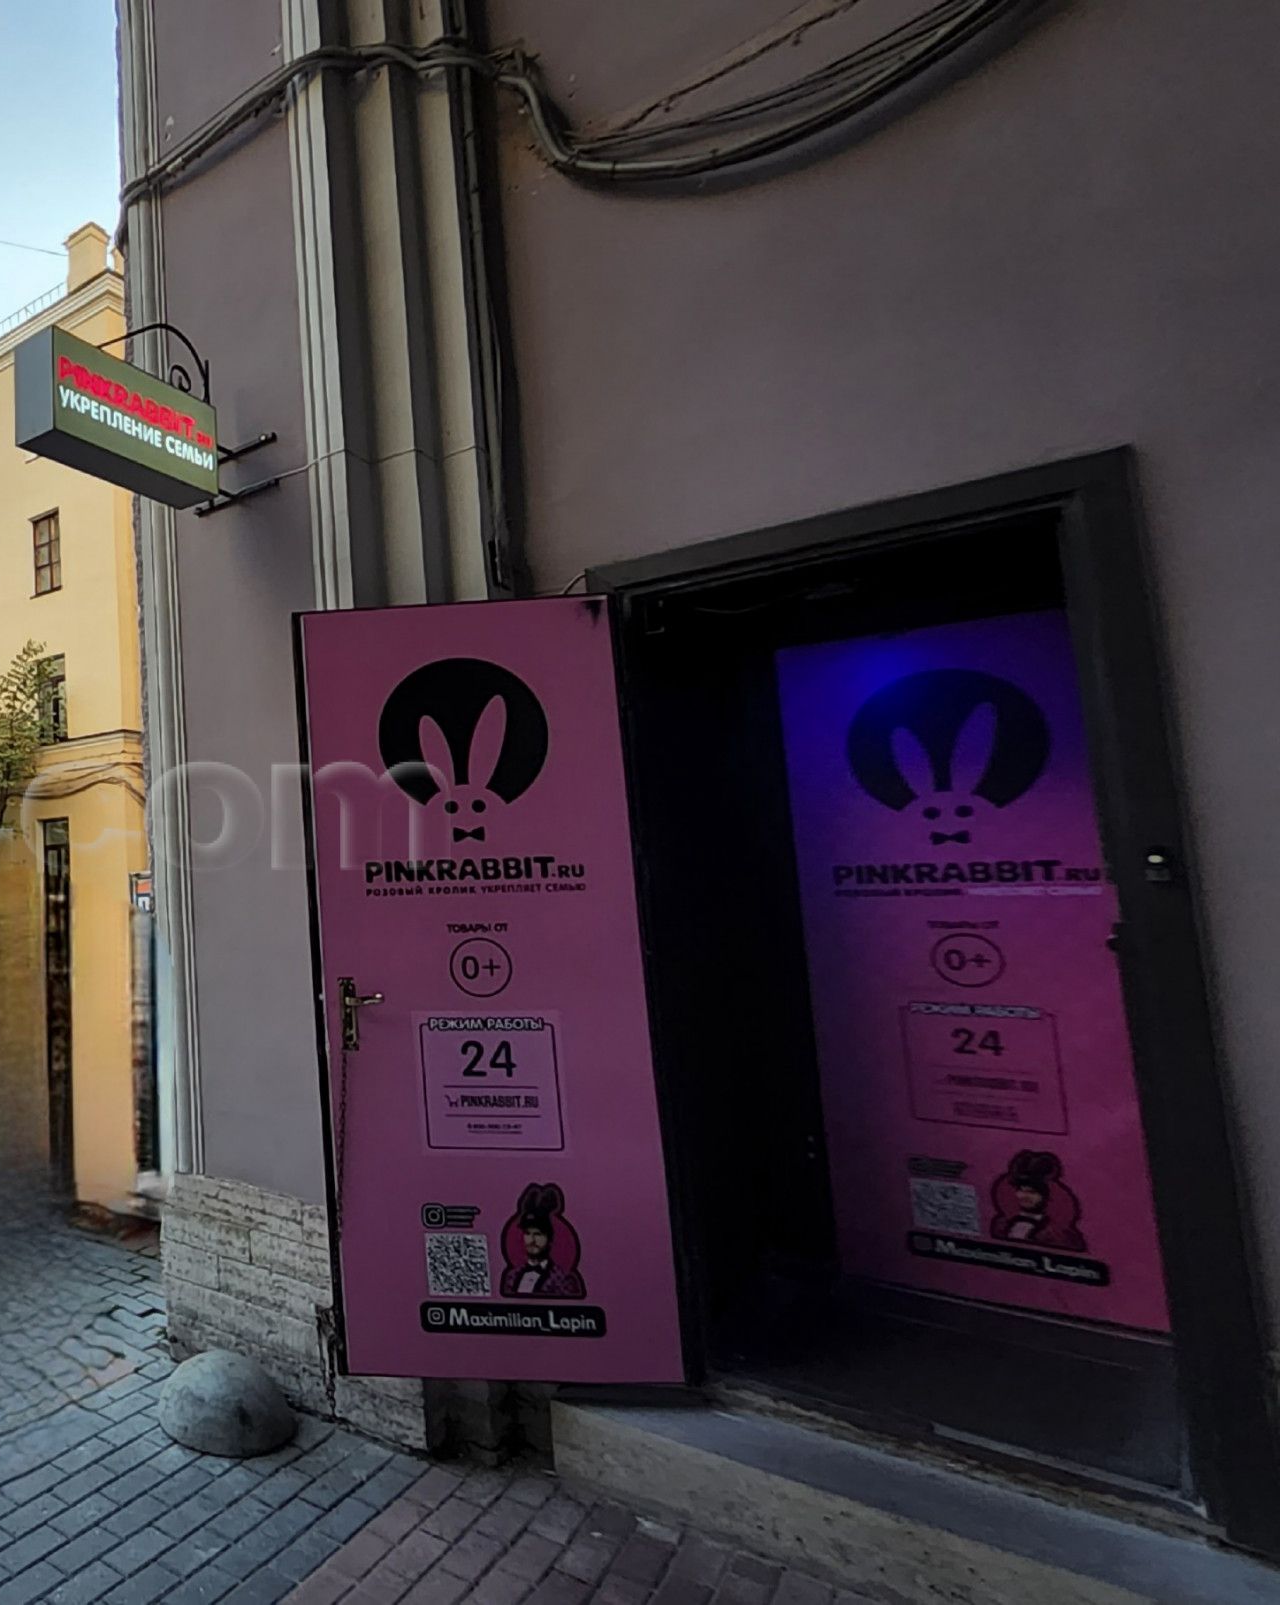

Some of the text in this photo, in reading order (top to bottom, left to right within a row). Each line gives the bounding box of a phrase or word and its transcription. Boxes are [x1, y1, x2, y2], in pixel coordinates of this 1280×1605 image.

[59, 385, 214, 471] УКРЕПЛЕНИЕ СЕМЬИ
[366, 886, 423, 897] РОЗОВЫЙ
[428, 885, 476, 896] КРОЛИК
[482, 883, 542, 894] УКРЕПЛЯЕТ
[447, 923, 509, 933] ТОВАРЫ ОТ
[461, 955, 501, 980] 0+
[943, 949, 992, 971] 0+
[429, 1017, 544, 1031] РЕЖИМ РАБОТЫ
[951, 1028, 1005, 1057] 24
[461, 1040, 517, 1078] 24
